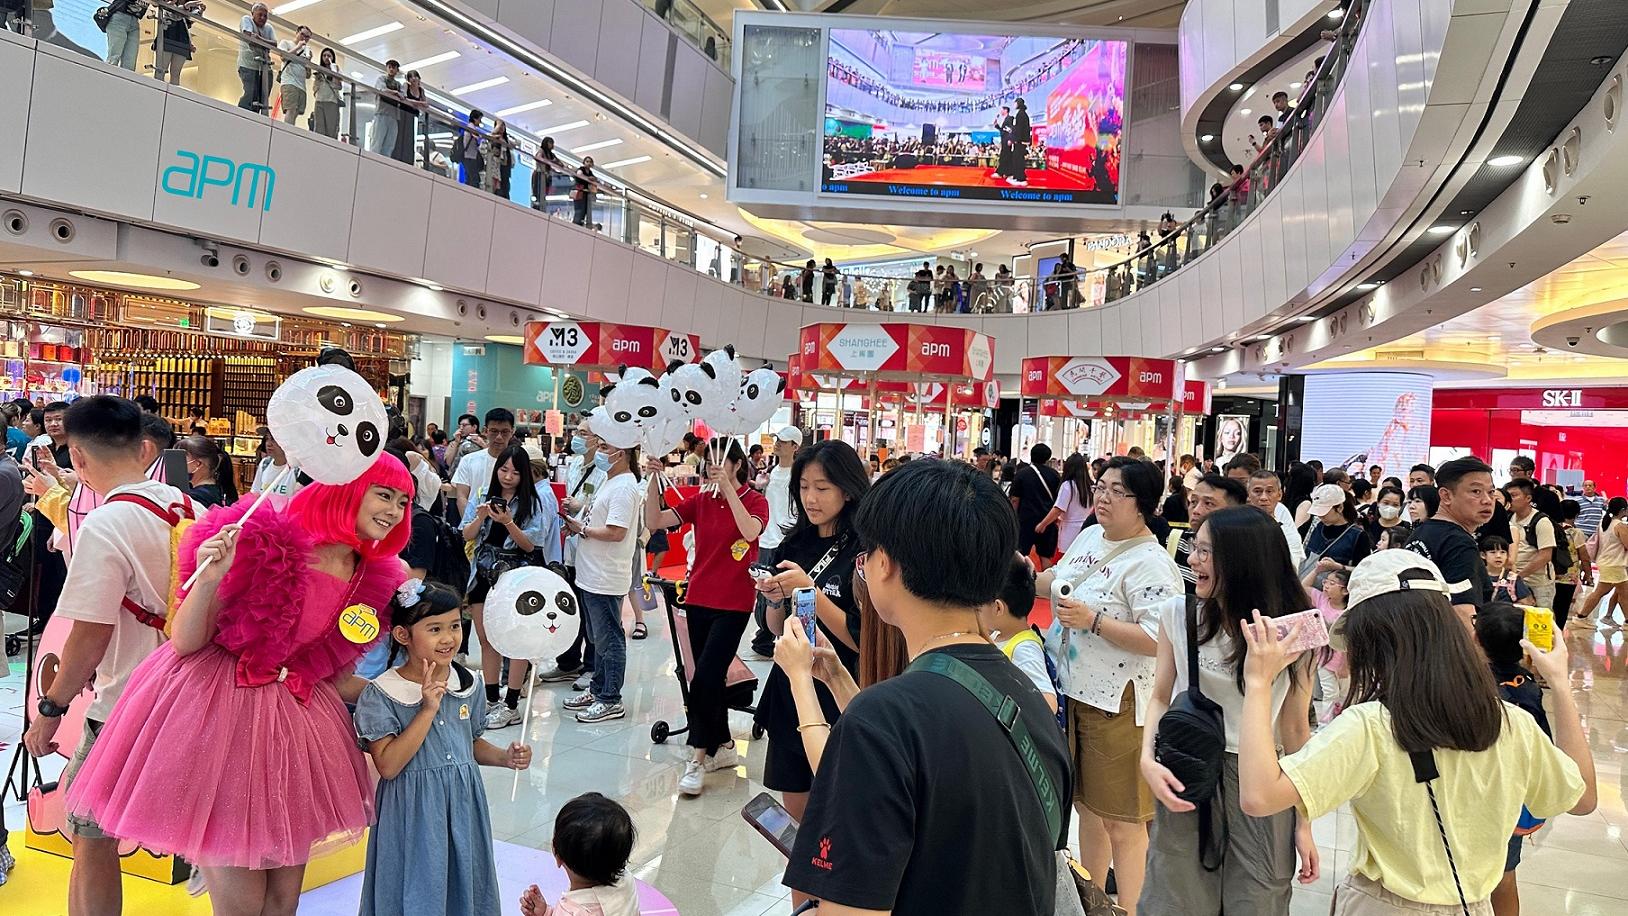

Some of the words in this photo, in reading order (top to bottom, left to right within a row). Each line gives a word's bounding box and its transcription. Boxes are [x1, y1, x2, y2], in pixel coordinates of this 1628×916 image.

[829, 184, 849, 192] apm
[889, 185, 927, 195] Welcome
[930, 188, 939, 196] to
[940, 189, 960, 198] apm
[1001, 190, 1039, 200] Welcome
[1053, 193, 1073, 202] apm
[549, 327, 578, 347] M3
[839, 338, 888, 348] SHANGHEE
[612, 338, 640, 353] apm
[668, 335, 688, 357] M3
[921, 342, 950, 357] apm
[1140, 371, 1162, 384] apm
[1183, 391, 1195, 401] pm
[1542, 389, 1583, 407] SK-II
[342, 610, 377, 640] apm
[1020, 735, 1056, 812] KELME
[811, 856, 833, 870] KELME
